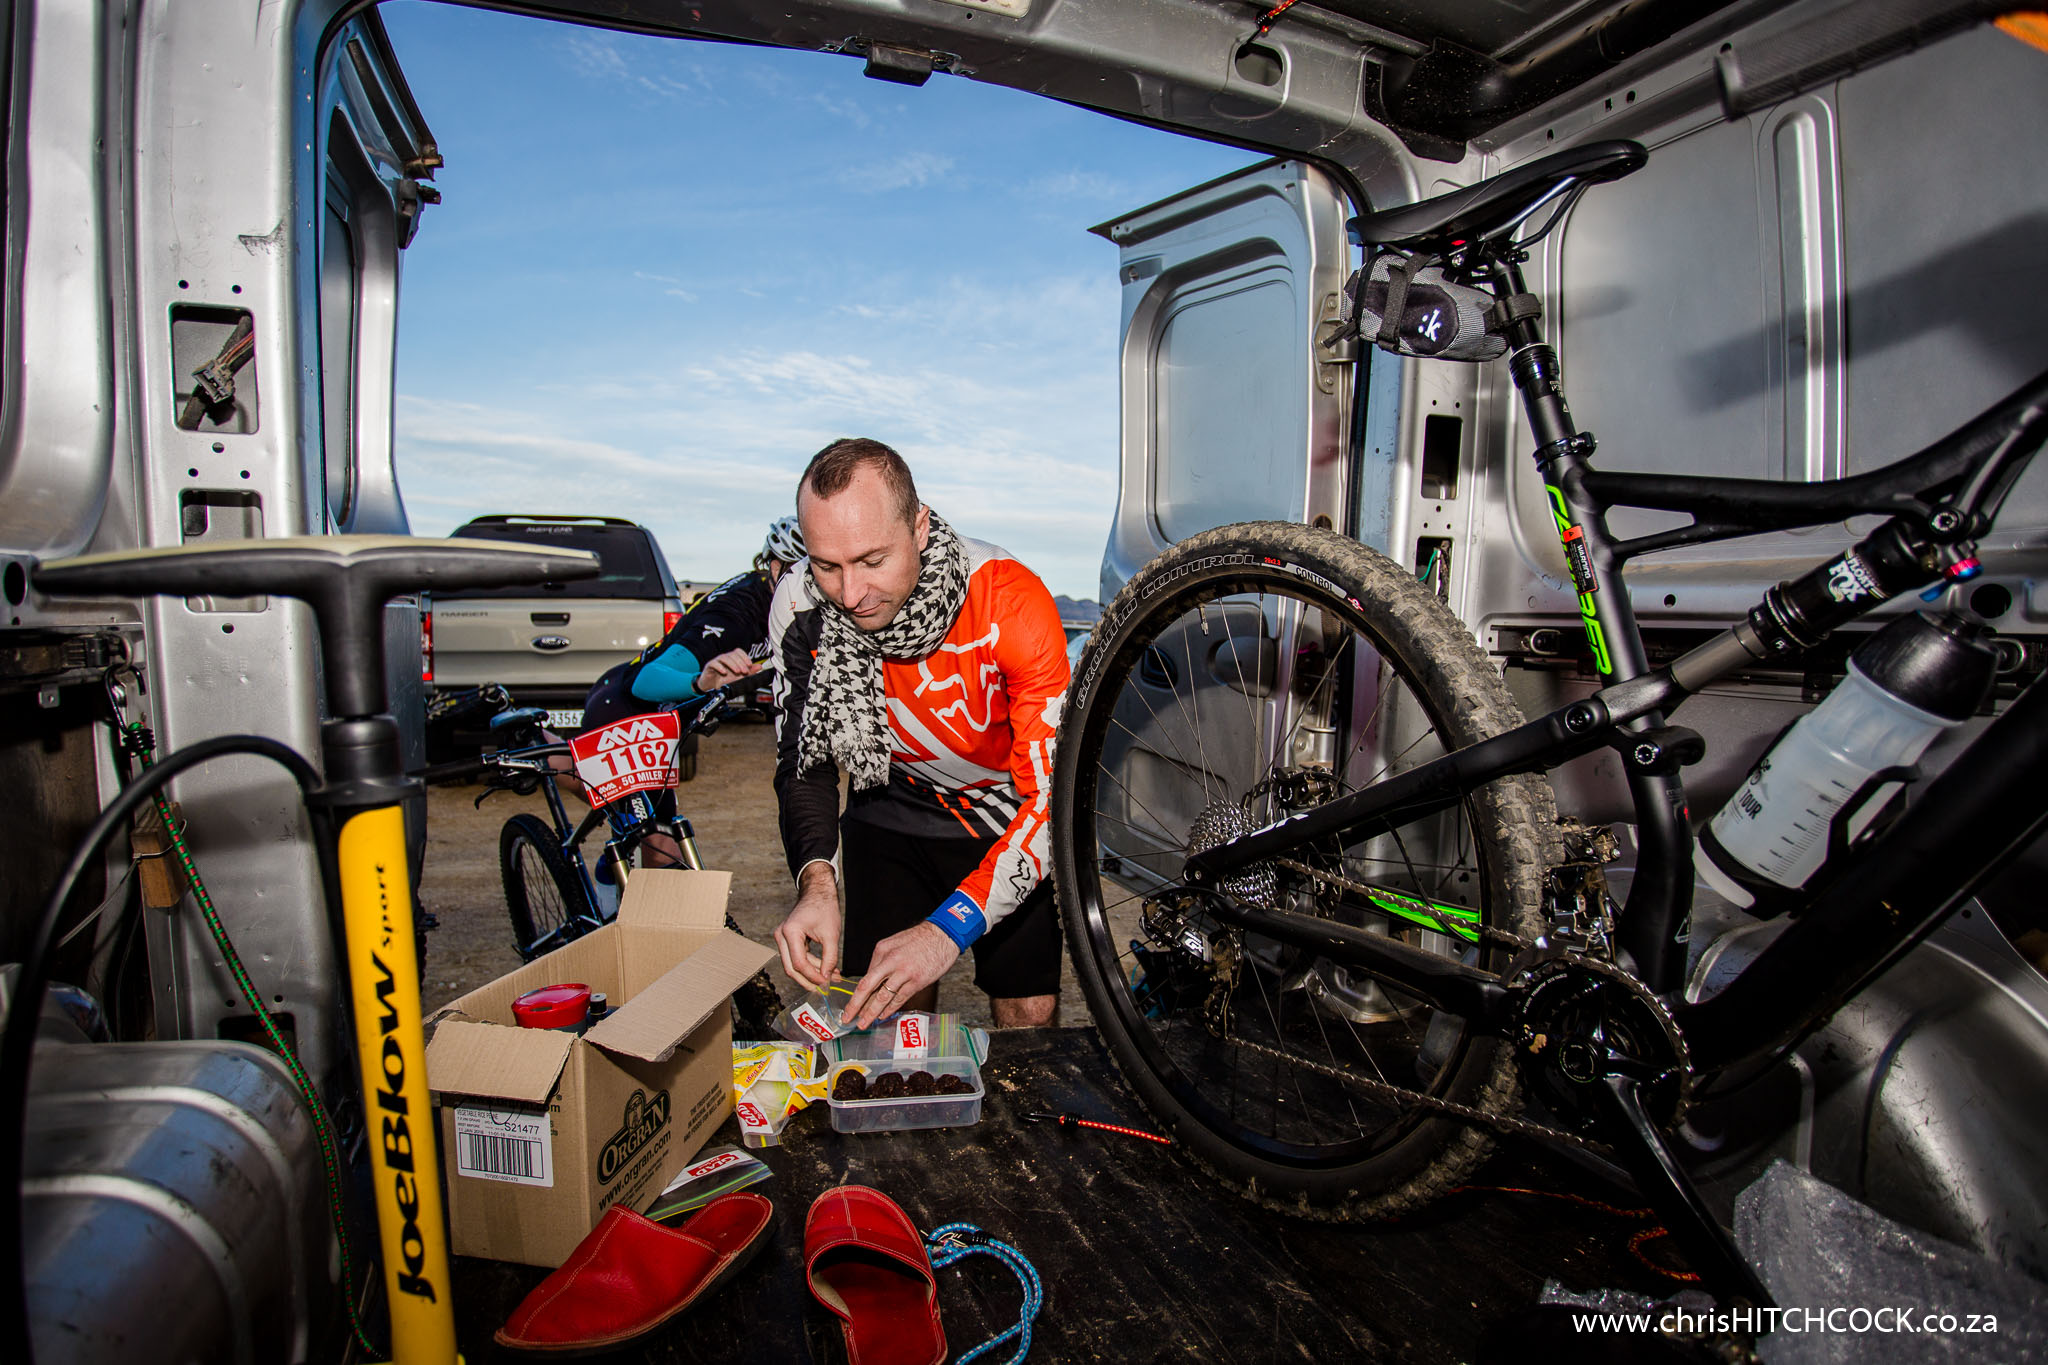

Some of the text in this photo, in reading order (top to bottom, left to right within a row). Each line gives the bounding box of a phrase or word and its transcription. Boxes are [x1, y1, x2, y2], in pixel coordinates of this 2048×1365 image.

[1295, 566, 1334, 592] CONTROL
[1545, 484, 1613, 676] CABER
[1828, 560, 1868, 602] FOX
[1847, 557, 1875, 589] FLOAT
[1076, 554, 1261, 710] GROUND CONTROL
[601, 740, 670, 777] 1162
[621, 774, 636, 787] 50
[637, 770, 663, 783] MILER
[1739, 788, 1763, 820] TOUR
[951, 901, 974, 918] LP
[801, 1013, 832, 1039] GLAD
[907, 1019, 920, 1046] GLAD
[457, 1109, 478, 1118] VEGETABLE
[478, 1111, 487, 1119] RICE
[737, 1103, 760, 1126] GLAD
[504, 1122, 540, 1135] S21477
[598, 1131, 672, 1211] www.orgran.com
[696, 1156, 736, 1175] GLAD
